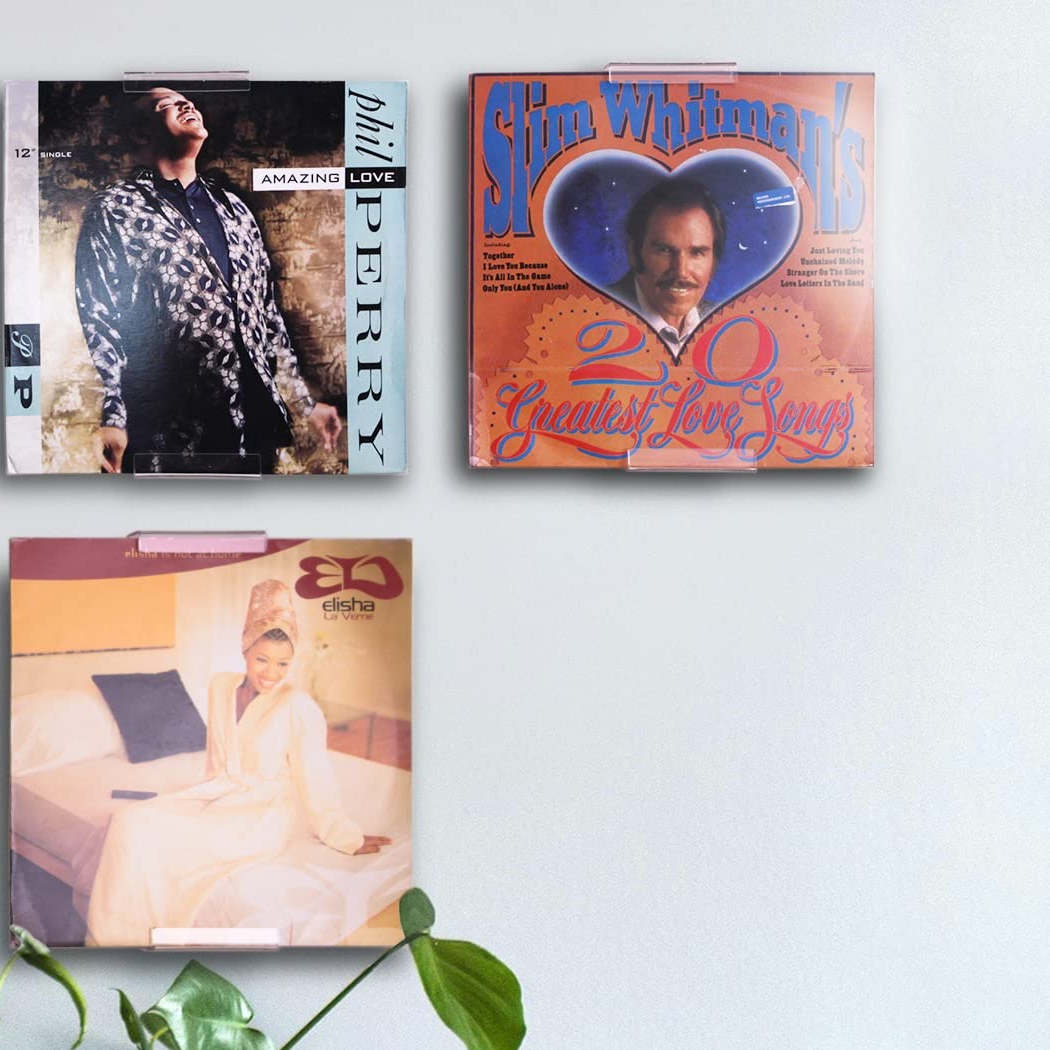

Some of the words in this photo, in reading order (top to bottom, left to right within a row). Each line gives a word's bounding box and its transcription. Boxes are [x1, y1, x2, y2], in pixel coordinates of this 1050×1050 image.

[348, 88, 395, 163] phil
[483, 81, 596, 238] Slim
[600, 79, 867, 237] Whitman's
[261, 172, 341, 185] AMAZING
[350, 171, 396, 183] LOVE
[483, 252, 515, 260] Together
[506, 262, 519, 270] You
[520, 262, 548, 270] Because
[787, 268, 818, 277] Stranger
[819, 268, 829, 276] On
[830, 268, 844, 276] The
[483, 273, 494, 281] It's
[495, 273, 506, 281] All
[531, 272, 551, 280] Game
[780, 280, 797, 288] Love
[833, 279, 846, 287] The
[482, 284, 498, 293] Only
[500, 284, 513, 292] You
[513, 283, 531, 292] (And
[532, 283, 545, 291] You
[546, 282, 569, 291] Alone)
[356, 190, 385, 467] PERRY
[568, 315, 779, 387] 20
[13, 373, 33, 410] P
[490, 379, 660, 463] Greatest
[646, 379, 743, 460] Love
[734, 376, 855, 464] Songs
[322, 597, 375, 612] elisha
[324, 612, 338, 620] La
